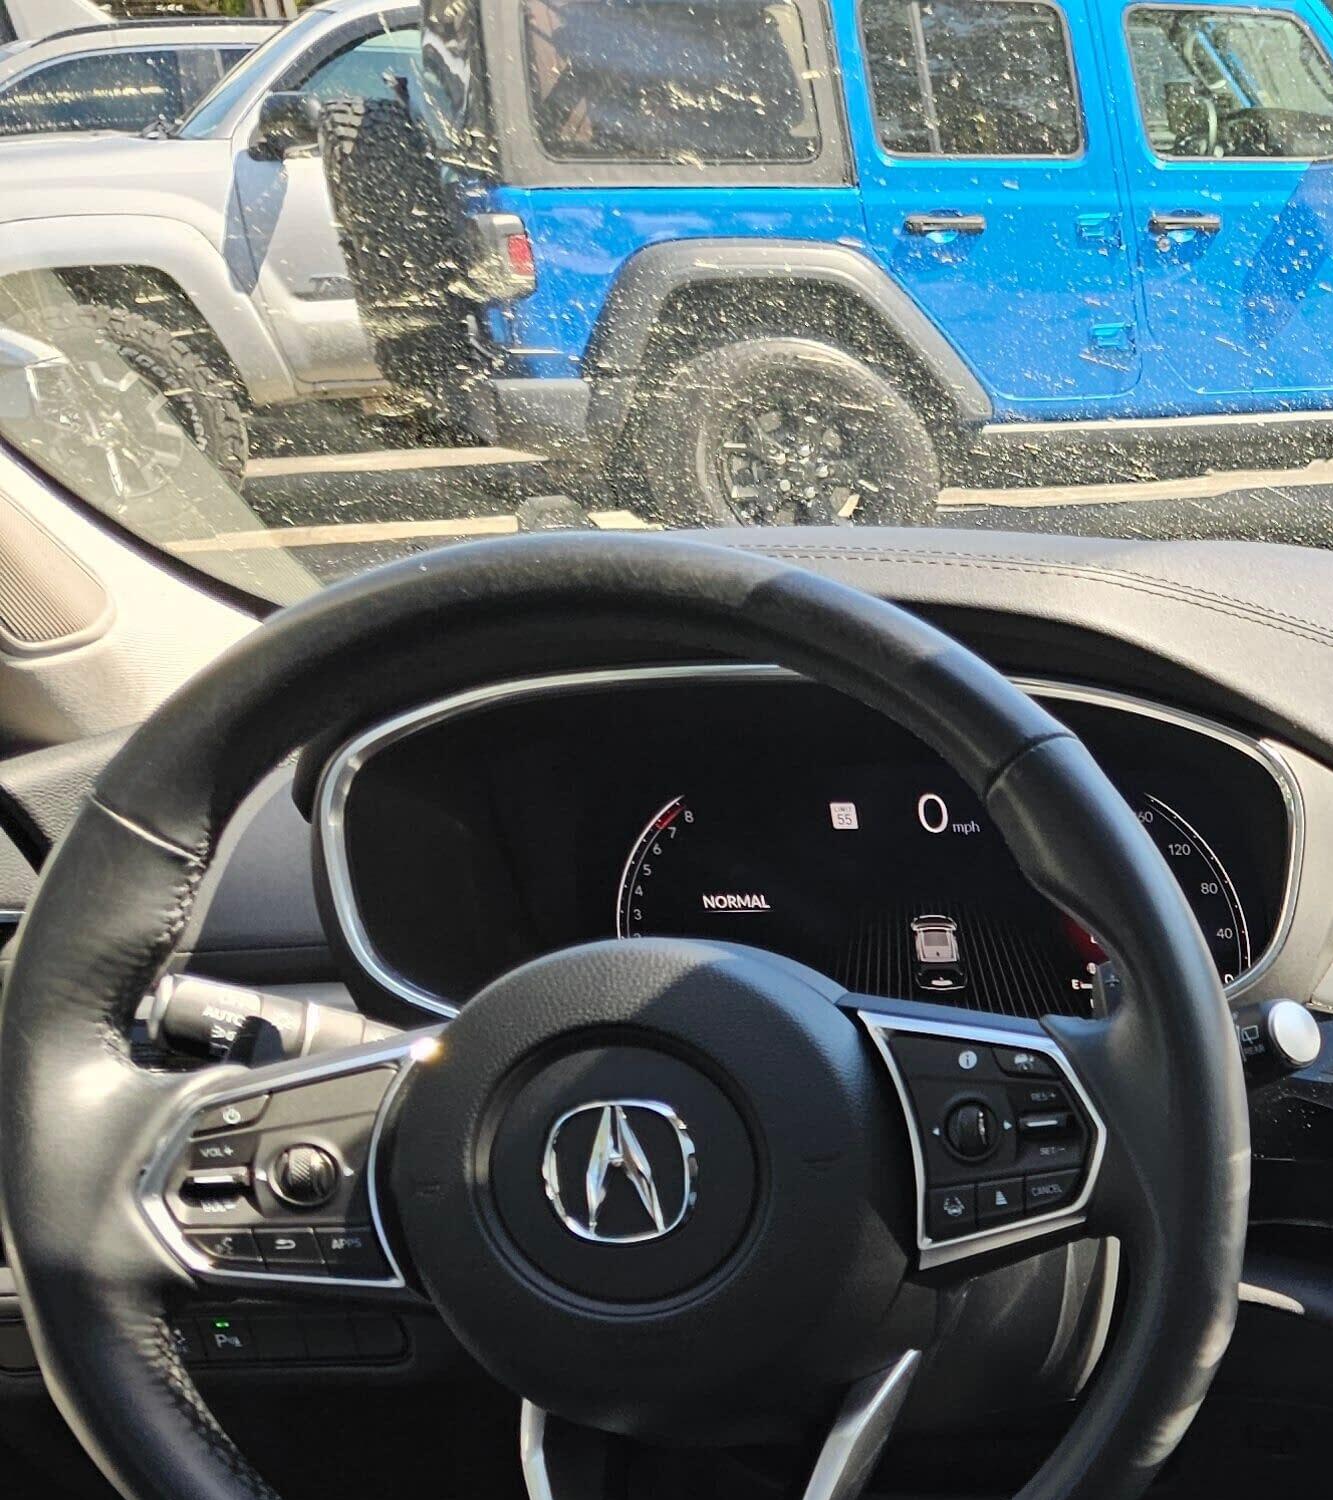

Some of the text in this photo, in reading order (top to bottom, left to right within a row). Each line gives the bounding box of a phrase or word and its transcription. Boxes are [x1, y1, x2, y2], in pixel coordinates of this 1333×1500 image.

[684, 810, 695, 824] 8
[837, 813, 853, 826] 55
[917, 793, 981, 836] 0 mph
[667, 826, 677, 839] 7
[653, 843, 662, 855] 6
[1168, 843, 1191, 856] 120
[642, 864, 652, 876] 5
[634, 884, 643, 897] 4
[1200, 882, 1218, 895] 80
[702, 894, 771, 909] NORMAL
[633, 908, 643, 921] 3
[1216, 927, 1233, 939] 40
[1031, 1183, 1063, 1197] CANCEL
[331, 1237, 362, 1250] APPS
